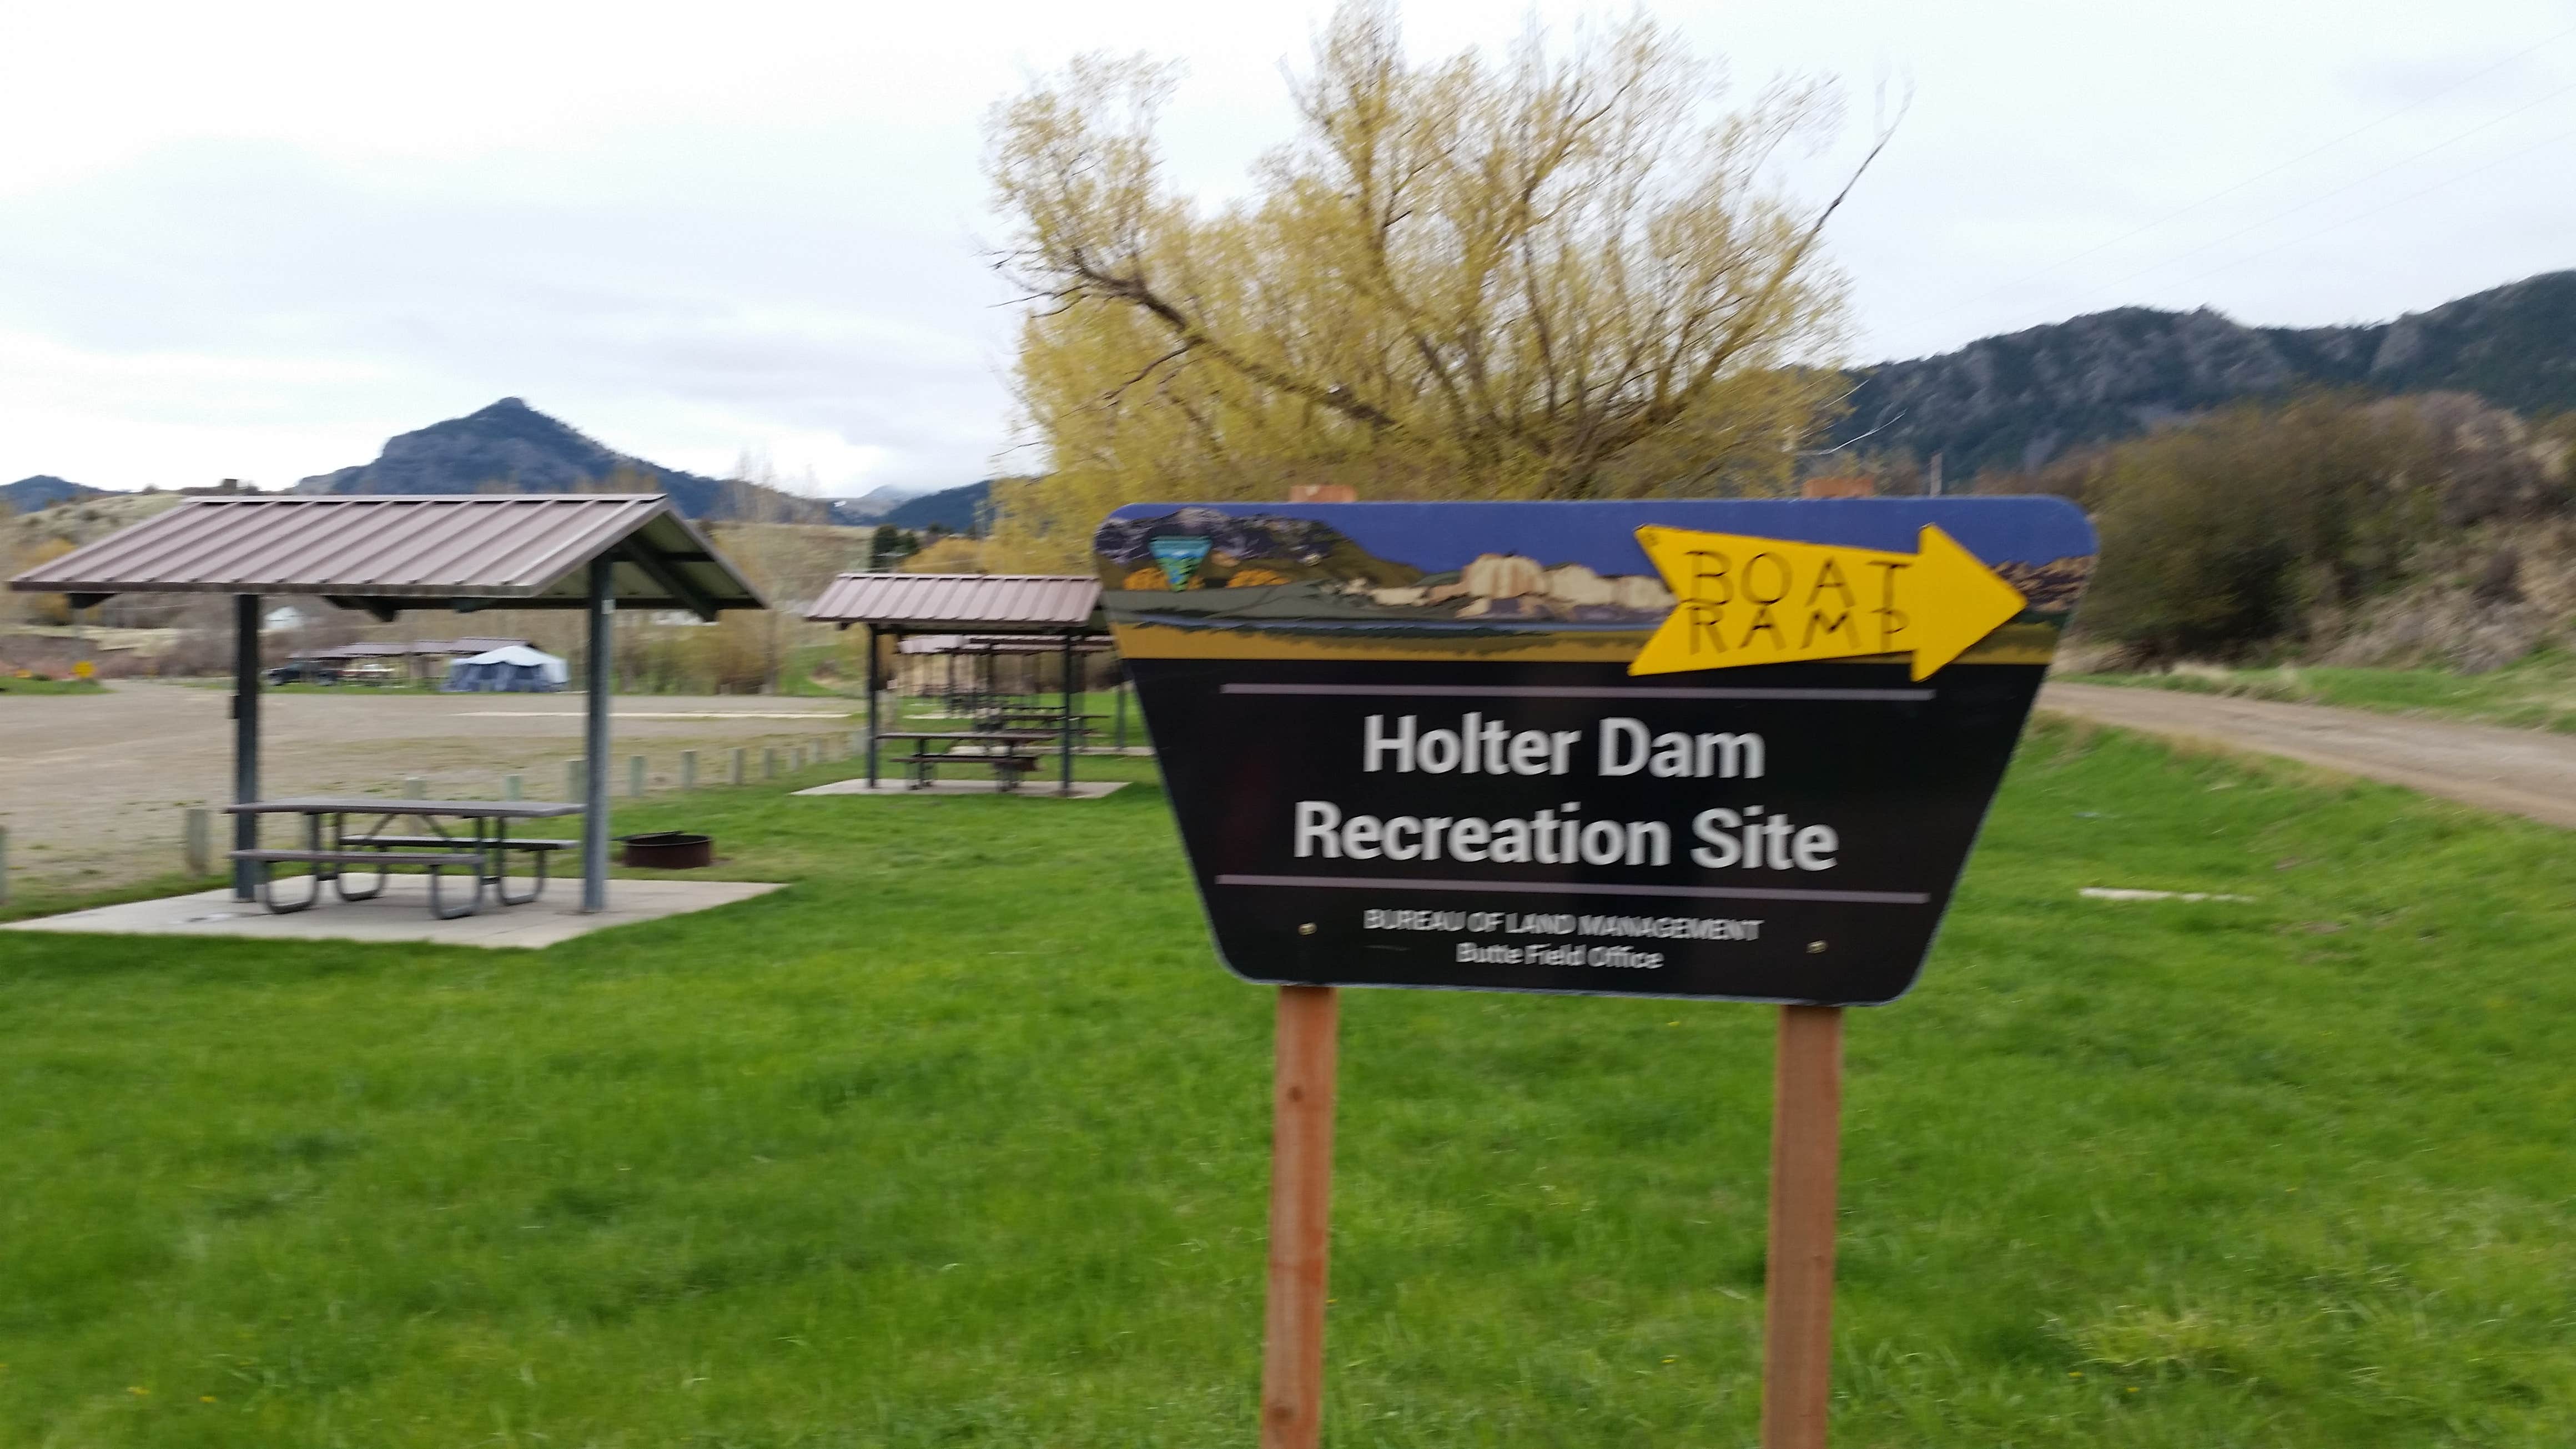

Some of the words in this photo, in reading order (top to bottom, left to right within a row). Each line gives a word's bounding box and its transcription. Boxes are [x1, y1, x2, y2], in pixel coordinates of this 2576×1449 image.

[1682, 550, 1910, 605] BOAT
[1684, 605, 1910, 655] RAMP
[1363, 712, 1581, 775] Holter
[1598, 717, 1765, 778] Dam
[1294, 801, 1671, 866] Recreation
[1690, 805, 1839, 871] Site
[1363, 909, 1467, 932] BUREAU
[1467, 911, 1506, 932] OF
[1505, 913, 1577, 934] LAND
[1577, 914, 1765, 941] MANAGEMENT
[1456, 942, 1523, 964] Butte
[1525, 943, 1587, 966] Field
[1587, 945, 1664, 969] Office
